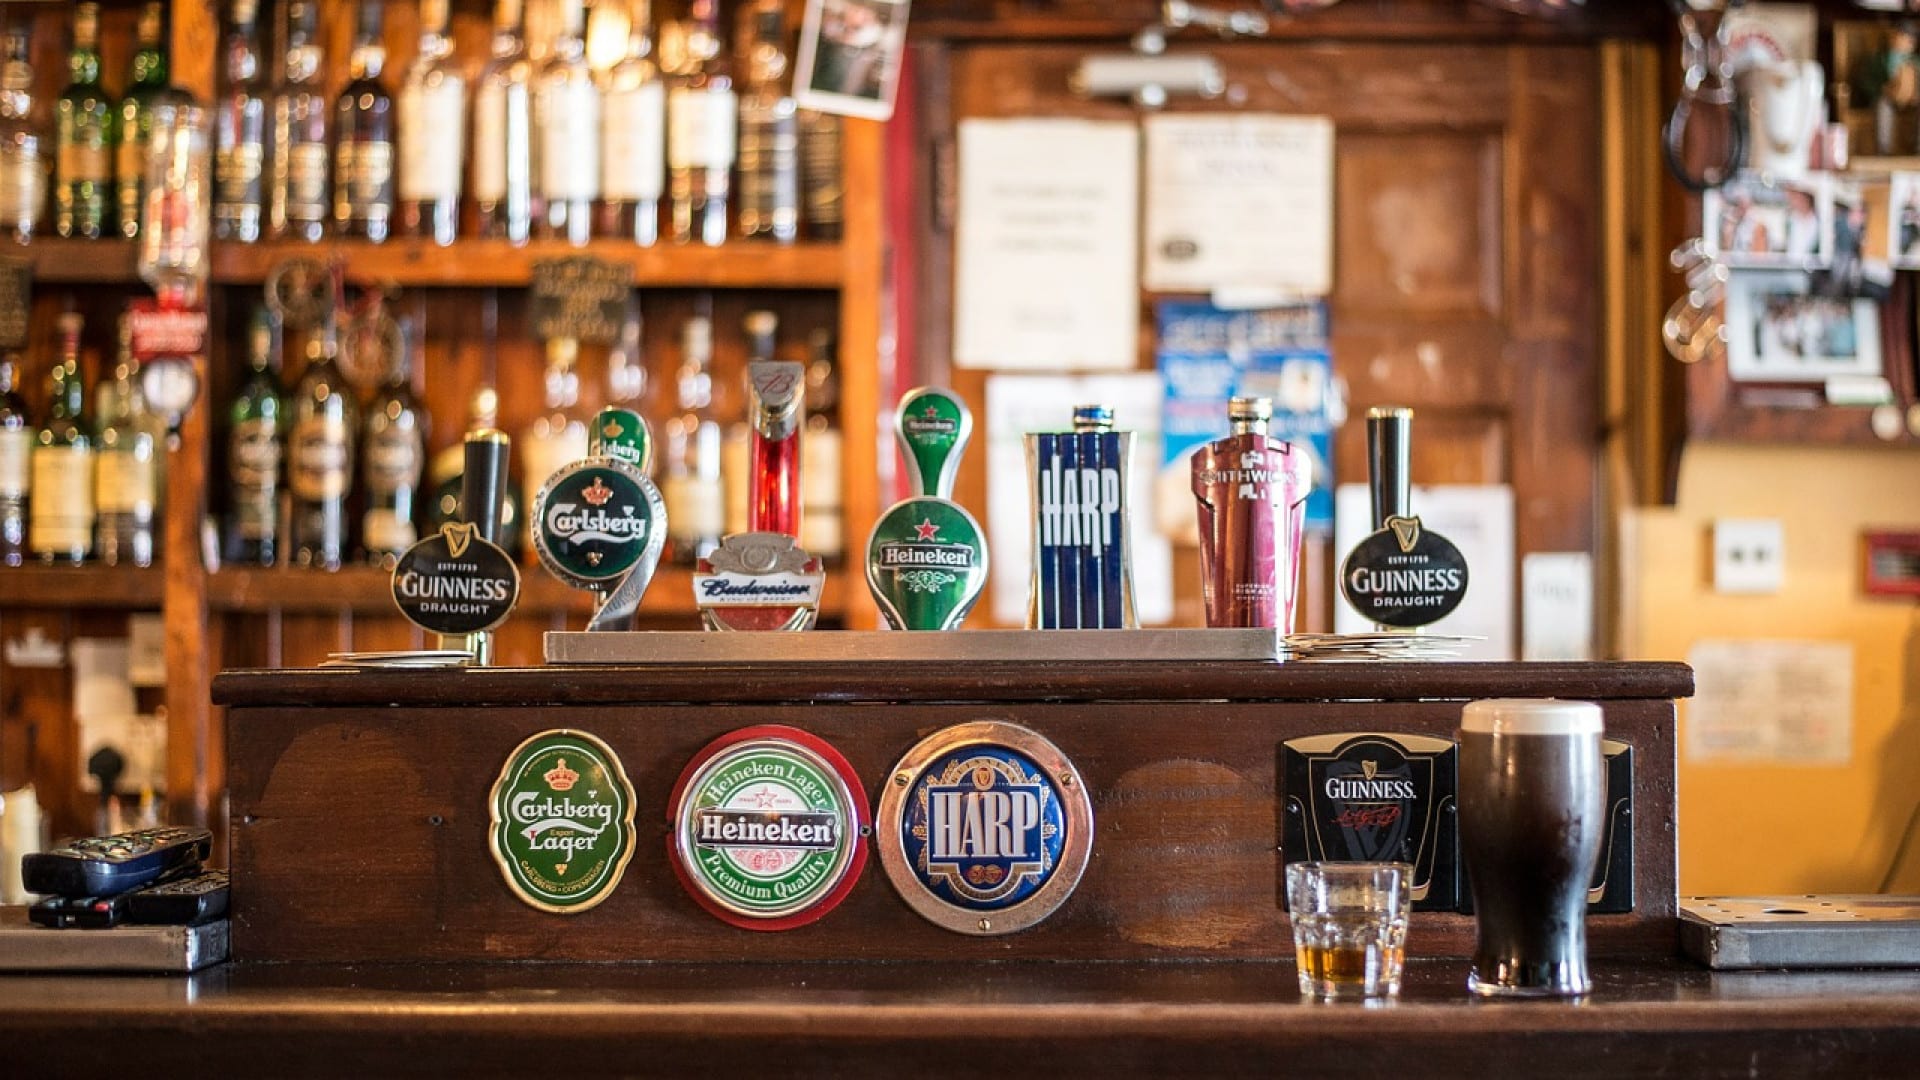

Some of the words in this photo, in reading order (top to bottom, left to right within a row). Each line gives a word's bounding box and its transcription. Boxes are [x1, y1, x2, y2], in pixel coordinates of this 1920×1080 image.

[1042, 455, 1120, 557] HARP
[547, 504, 646, 540] Carlsberg
[886, 548, 967, 565] Heineken
[401, 571, 508, 601] GUINNESS
[701, 579, 811, 597] Budweiser
[1351, 567, 1460, 593] GUINNESS
[420, 602, 490, 616] DRAUGHT
[1373, 596, 1445, 608] DRAUGHT
[706, 762, 784, 803] Heineken
[785, 765, 828, 807] Lager
[1325, 777, 1415, 799] GUINNESS
[511, 791, 612, 826] Carlsberg
[701, 815, 832, 843] Heineken
[932, 791, 1039, 858] HARP
[528, 831, 598, 863] Lager
[705, 854, 771, 899] Premium
[774, 855, 828, 898] Quality
